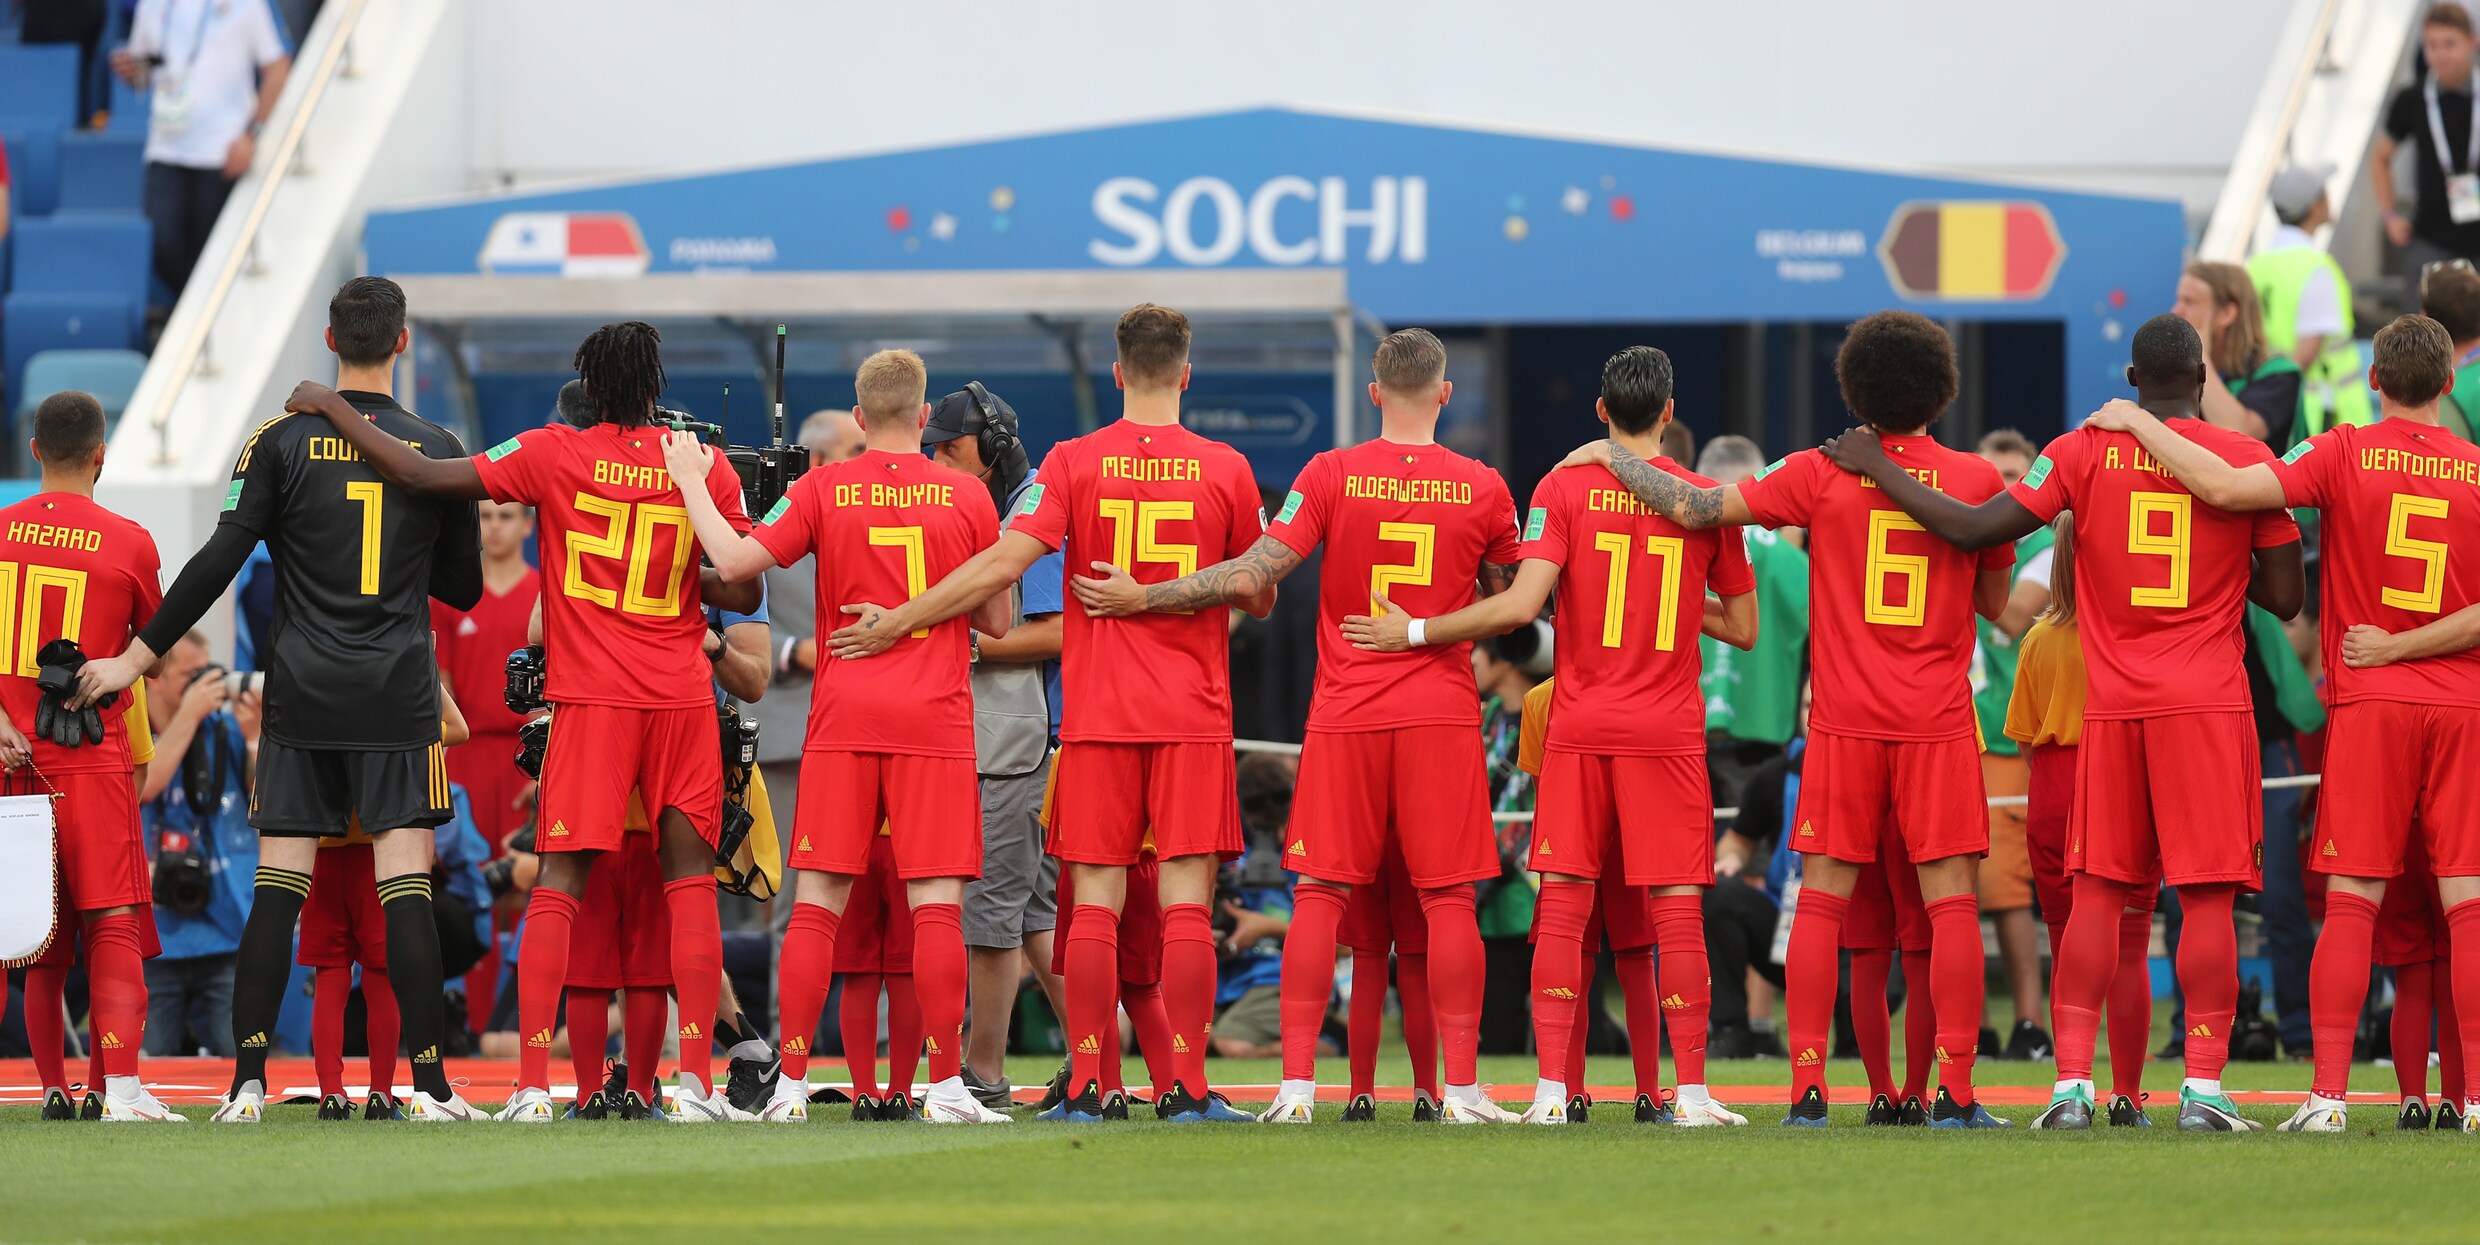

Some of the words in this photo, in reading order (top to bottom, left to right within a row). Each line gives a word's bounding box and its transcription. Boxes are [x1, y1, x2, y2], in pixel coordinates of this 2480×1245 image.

[1089, 176, 1427, 265] SOCHI
[1102, 456, 1201, 482] MEUNIER
[1345, 475, 1472, 505] ALDERWEIRELD
[2106, 447, 2125, 470] R.
[2361, 448, 2480, 487] VERTONGHE
[835, 483, 863, 508] DE
[870, 483, 954, 509] BRUYNE
[7, 521, 102, 553] HAZARD
[346, 481, 383, 595] 1
[563, 490, 690, 616] 20
[1099, 498, 1198, 615] 15
[1865, 509, 1928, 626] 6
[2128, 491, 2191, 608] 9
[2381, 493, 2449, 613] 5
[868, 526, 929, 638] 7
[1371, 521, 1435, 618] 2
[1595, 531, 1684, 652] 11
[414, 1056, 438, 1064] adidas
[783, 1047, 808, 1055] adidas
[1077, 1047, 1100, 1055] adidas
[1797, 1058, 1820, 1067] adidas
